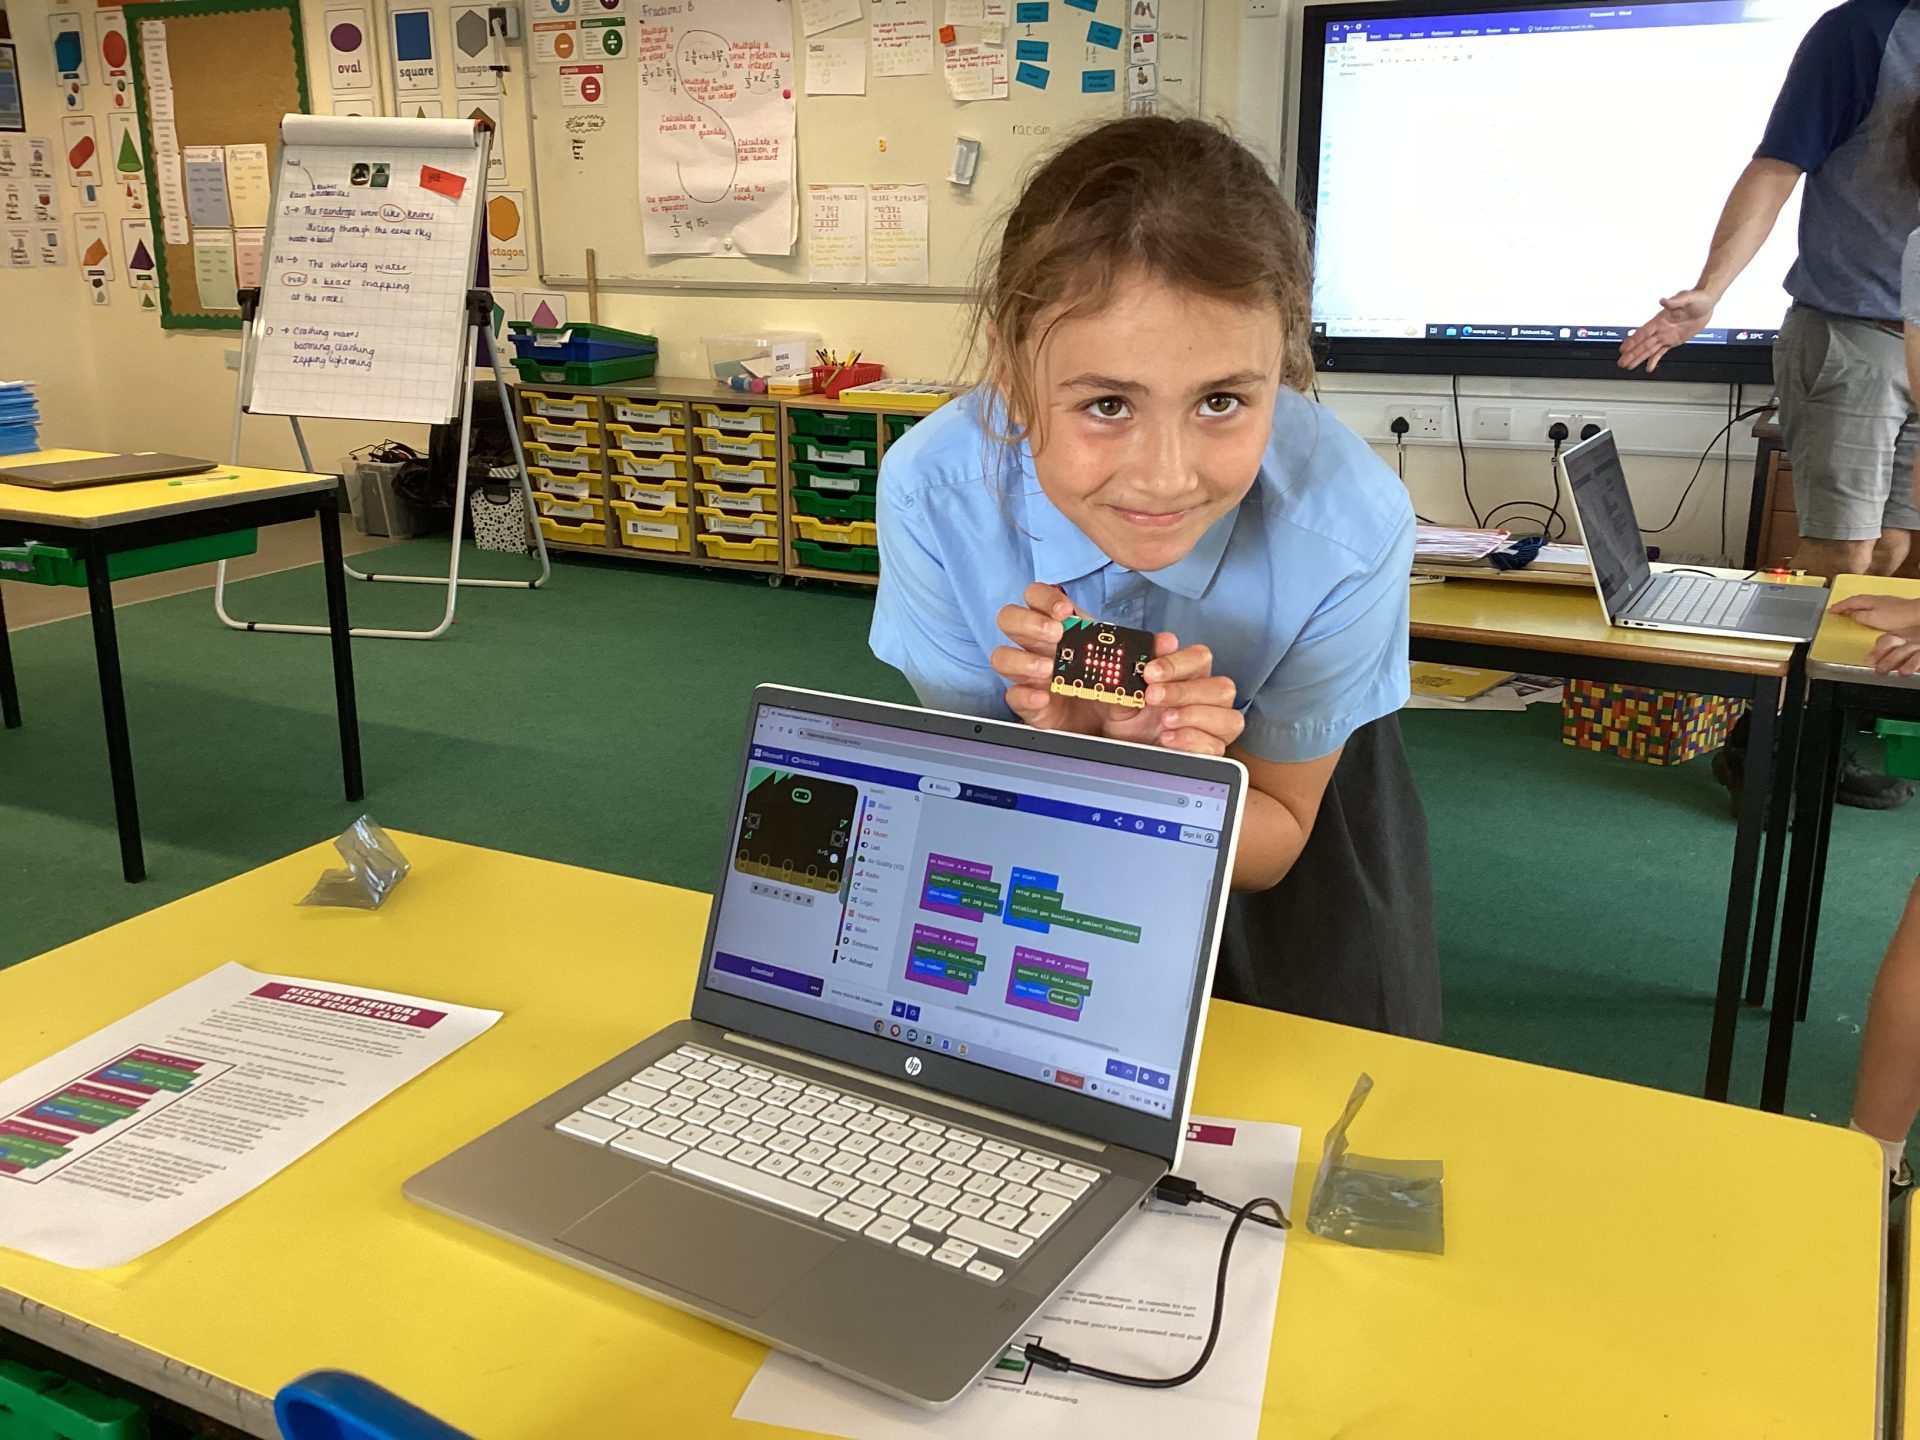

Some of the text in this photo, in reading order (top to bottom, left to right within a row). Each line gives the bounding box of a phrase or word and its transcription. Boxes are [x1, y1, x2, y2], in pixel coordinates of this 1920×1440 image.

[642, 4, 681, 17] Fractions
[749, 51, 777, 61] fraction
[338, 60, 362, 74] oval
[400, 66, 434, 80] square
[662, 114, 694, 123] Calculate
[1012, 124, 1050, 136] racism
[738, 138, 770, 146] Calculate
[734, 184, 750, 193] Find
[319, 208, 356, 217] raindrops
[374, 226, 387, 235] the
[414, 227, 432, 240] sky
[275, 255, 284, 264] M
[308, 259, 324, 269] The
[375, 263, 407, 271] water
[323, 278, 352, 287] beast
[362, 280, 410, 293] snapping
[304, 293, 317, 301] the
[776, 353, 790, 362] WHEAL
[776, 363, 790, 372] COATES
[762, 751, 783, 761] Microsoft
[876, 816, 888, 824] Input
[873, 830, 888, 838] Music
[1183, 831, 1196, 839] Sign
[876, 859, 893, 869] Quality
[865, 870, 879, 879] Radio
[970, 867, 990, 875] pressed
[862, 885, 878, 894] Loops
[931, 874, 950, 882] measure
[976, 884, 998, 893] readings
[1016, 888, 1030, 896] setup
[860, 899, 873, 907] Logic
[858, 912, 880, 922] Variables
[1012, 904, 1038, 913] establish
[1051, 913, 1074, 922] baseline
[1082, 920, 1103, 929] ambient
[1105, 924, 1138, 937] temperature
[923, 930, 940, 940] button
[955, 938, 976, 947] pressed
[852, 939, 879, 951] Extensions
[849, 956, 873, 968] Advanced
[937, 949, 947, 957] all
[948, 952, 959, 960] data
[961, 955, 984, 966] readings
[1024, 953, 1042, 962] button
[1064, 962, 1086, 972] pressed
[1018, 967, 1090, 990] measure all data readings
[280, 993, 410, 1023] AFTER SCHOOL CLUB
[360, 998, 421, 1017] MENTORS
[907, 1056, 920, 1075] hp
[1076, 1290, 1102, 1300] quality
[1145, 1300, 1171, 1309] needs
[1072, 1296, 1087, 1304] first
[1089, 1300, 1124, 1310] switched
[1157, 1308, 1182, 1317] needs
[1091, 1322, 1117, 1330] you've
[1119, 1325, 1134, 1333] just
[1136, 1328, 1167, 1337] created
[1169, 1331, 1185, 1339] and
[1025, 1389, 1078, 1404] sub-heading
